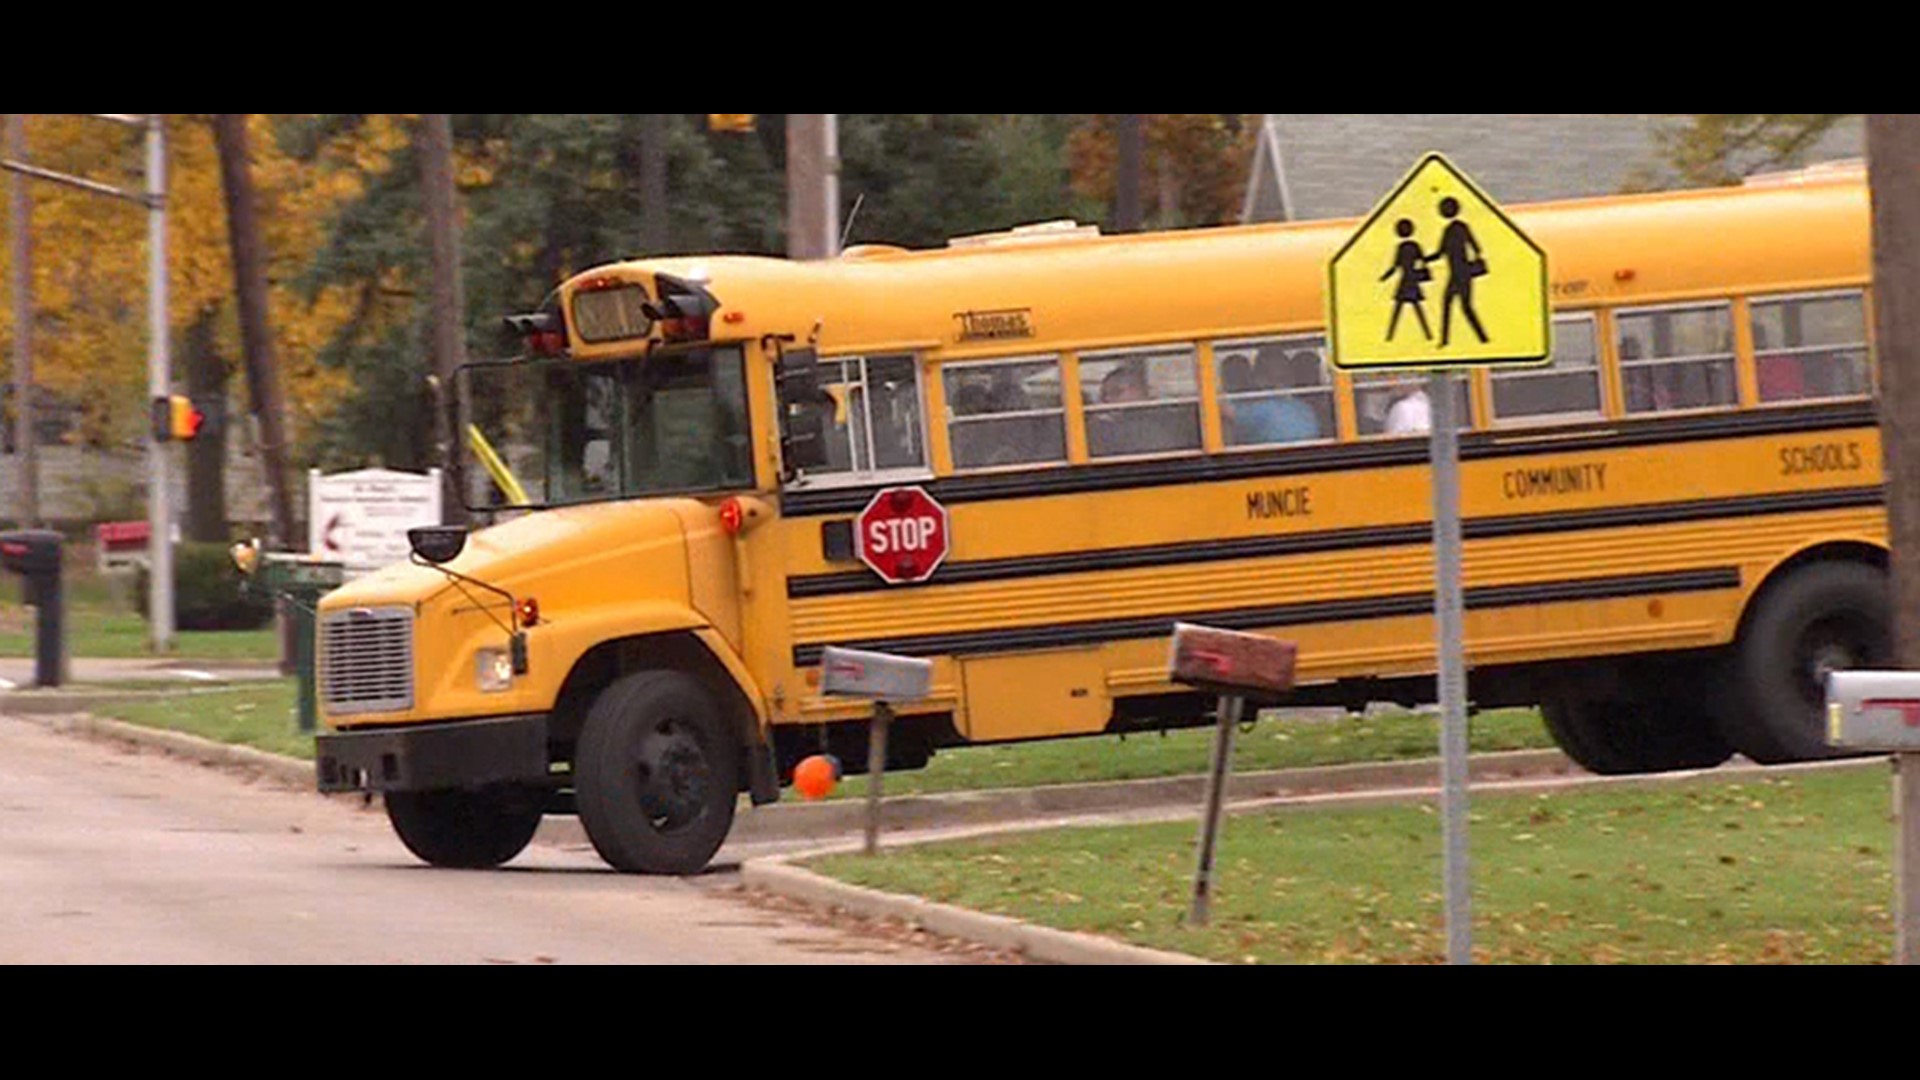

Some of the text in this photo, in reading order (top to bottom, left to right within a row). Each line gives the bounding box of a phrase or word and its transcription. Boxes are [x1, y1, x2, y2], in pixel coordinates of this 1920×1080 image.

[952, 308, 1032, 335] Thomas
[1246, 441, 1861, 520] MUNCIE COMMUNITY SCHOOLS
[869, 516, 936, 554] STOP
